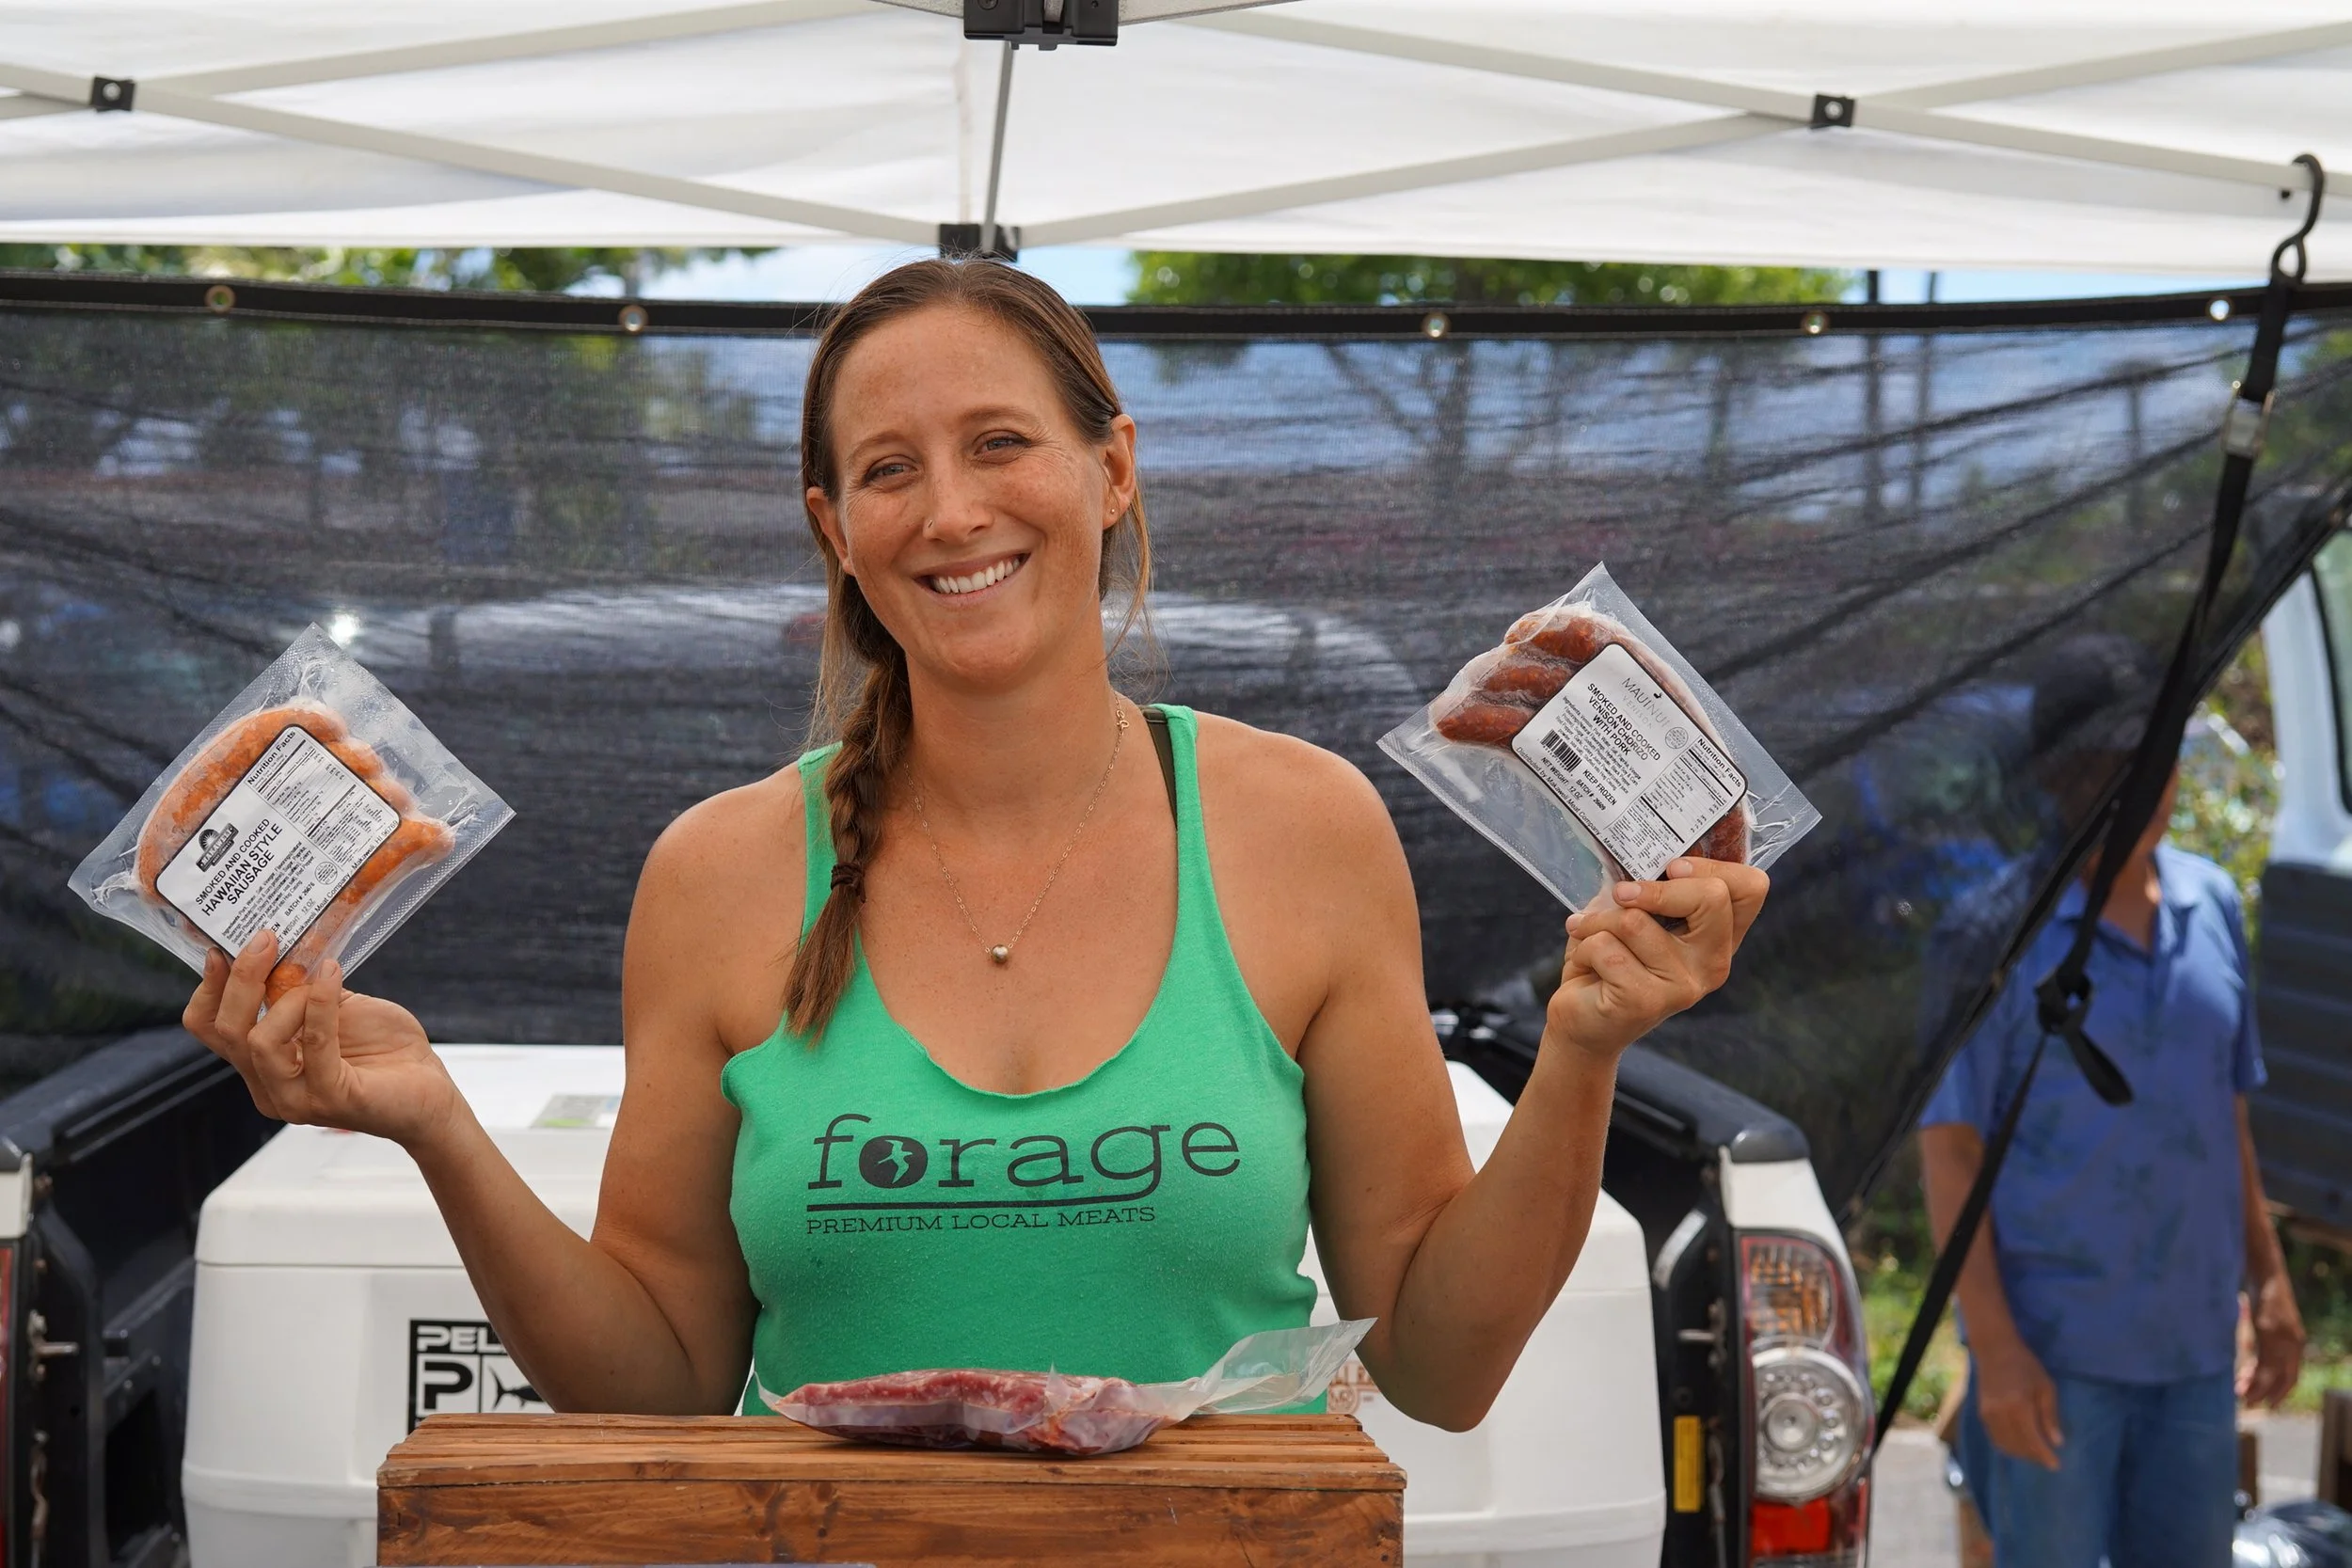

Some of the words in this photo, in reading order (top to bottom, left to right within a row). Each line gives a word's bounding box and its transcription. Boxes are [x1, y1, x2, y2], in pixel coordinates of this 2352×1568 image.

[1587, 682, 1618, 715] SMOKED
[1615, 713, 1632, 731] AND
[1629, 728, 1661, 761] COOKED
[1587, 695, 1619, 729] VENISON
[1615, 726, 1649, 761] CHORIZO
[1592, 714, 1612, 735] WITH
[1609, 733, 1630, 755] PORK
[1621, 694, 1654, 730] VENISON
[246, 750, 278, 784] Nutrition
[275, 729, 295, 752] Facts
[1540, 756, 1551, 768] NET
[1568, 784, 1576, 793] 12
[1573, 790, 1582, 800] OZ
[1696, 737, 1726, 768] Nutrition
[1724, 767, 1743, 787] Facts
[1517, 745, 1542, 772] Distributed
[1539, 769, 1548, 779] by
[1566, 798, 1581, 813] Meat
[1577, 810, 1601, 835] Company
[1625, 861, 1632, 869] HI
[1576, 778, 1591, 795] BATCH
[1582, 768, 1597, 785] KEEP
[1596, 783, 1617, 805] FROZEN
[194, 869, 227, 905] SMOKED
[223, 851, 241, 871] AND
[238, 817, 270, 853] COOKED
[199, 828, 232, 865] MAKAWELI
[200, 859, 252, 916] HAWAIIAN
[247, 822, 282, 861] STYLE
[225, 848, 276, 905] SAUSAGE
[314, 896, 328, 912] Meat
[326, 871, 351, 899] Company
[374, 835, 382, 844] HI
[283, 898, 300, 916] BATCH
[300, 905, 309, 913] 12
[305, 897, 315, 908] OZ
[807, 1113, 1241, 1204] forage
[806, 1213, 943, 1235] PREMIUM
[951, 1209, 1050, 1230] LOCAL
[1057, 1205, 1156, 1227] MEATS
[417, 1324, 508, 1354] PEL
